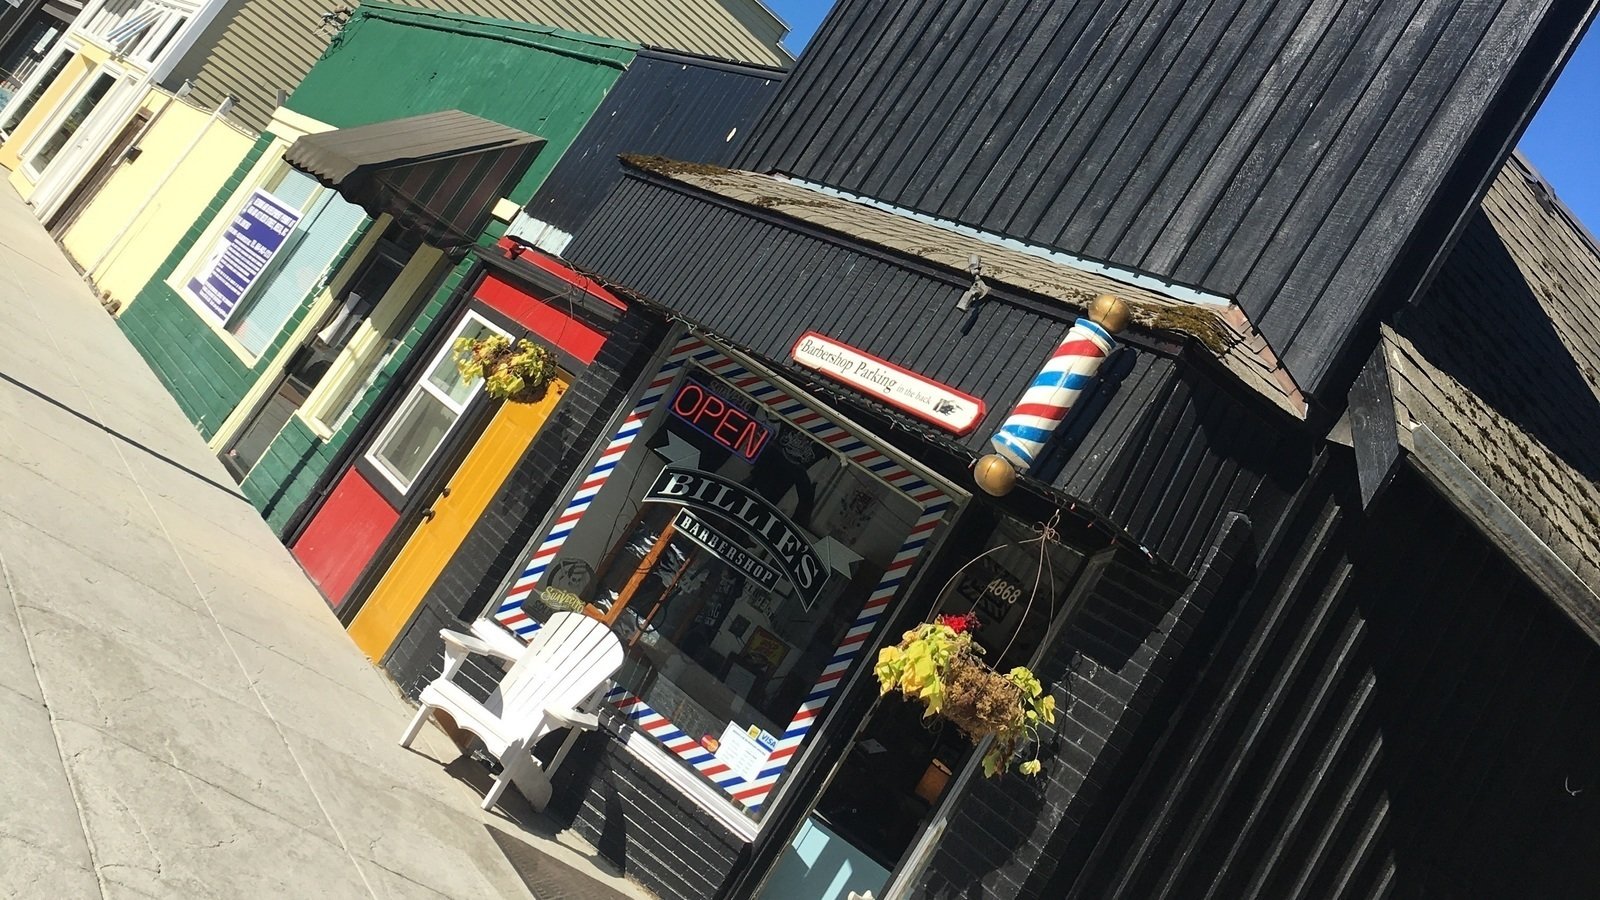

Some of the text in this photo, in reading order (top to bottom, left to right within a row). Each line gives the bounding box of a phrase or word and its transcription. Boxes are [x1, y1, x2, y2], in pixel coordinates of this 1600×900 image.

[801, 339, 933, 405] Barbershop Parking in the back
[674, 384, 769, 459] OPEN
[657, 472, 819, 590] BILLIE'S
[680, 515, 773, 583] BARBERSHOP
[988, 578, 1021, 604] 4868
[761, 733, 777, 748] VISA
